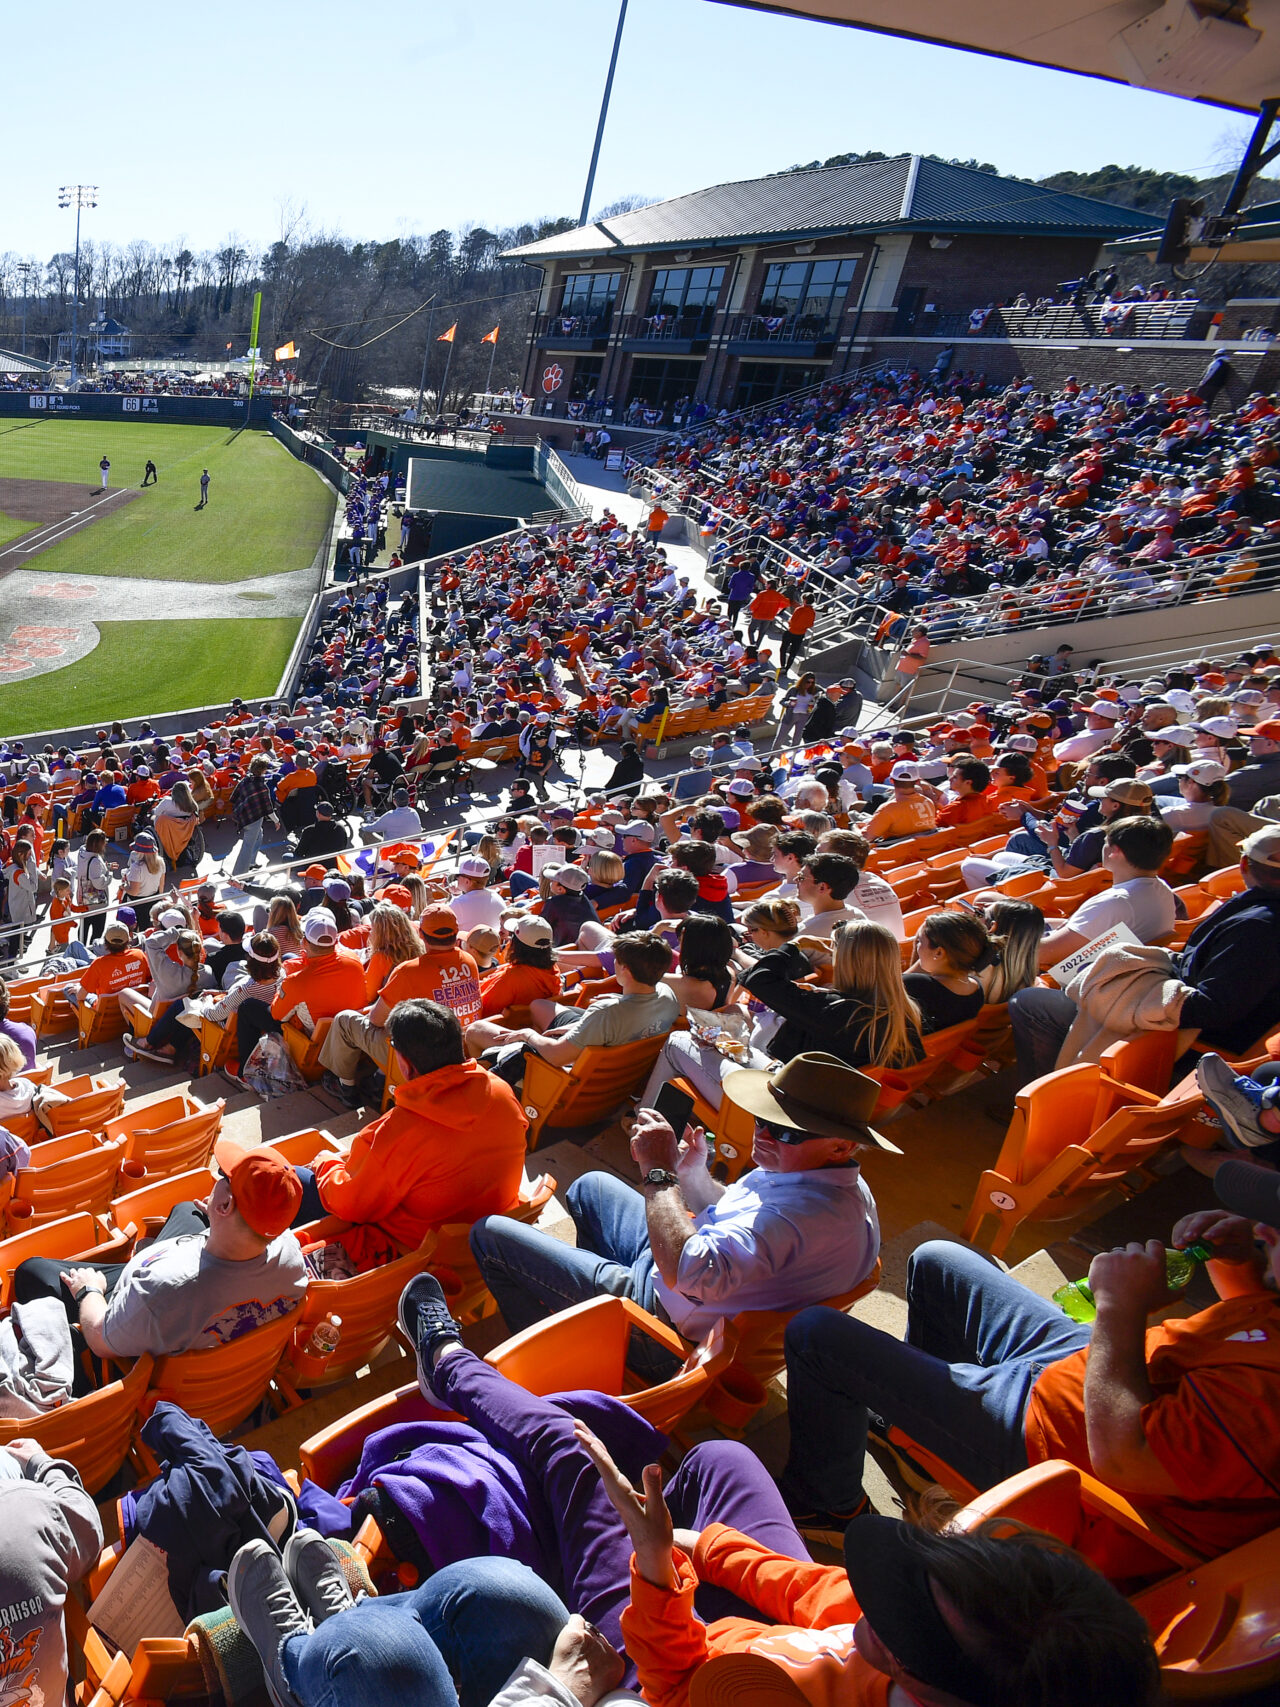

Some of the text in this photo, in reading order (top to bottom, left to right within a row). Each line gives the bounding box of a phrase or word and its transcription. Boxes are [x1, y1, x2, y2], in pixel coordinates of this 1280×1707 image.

[1059, 931, 1118, 974] 2022 CLEMSON
[439, 963, 471, 984] 12-0
